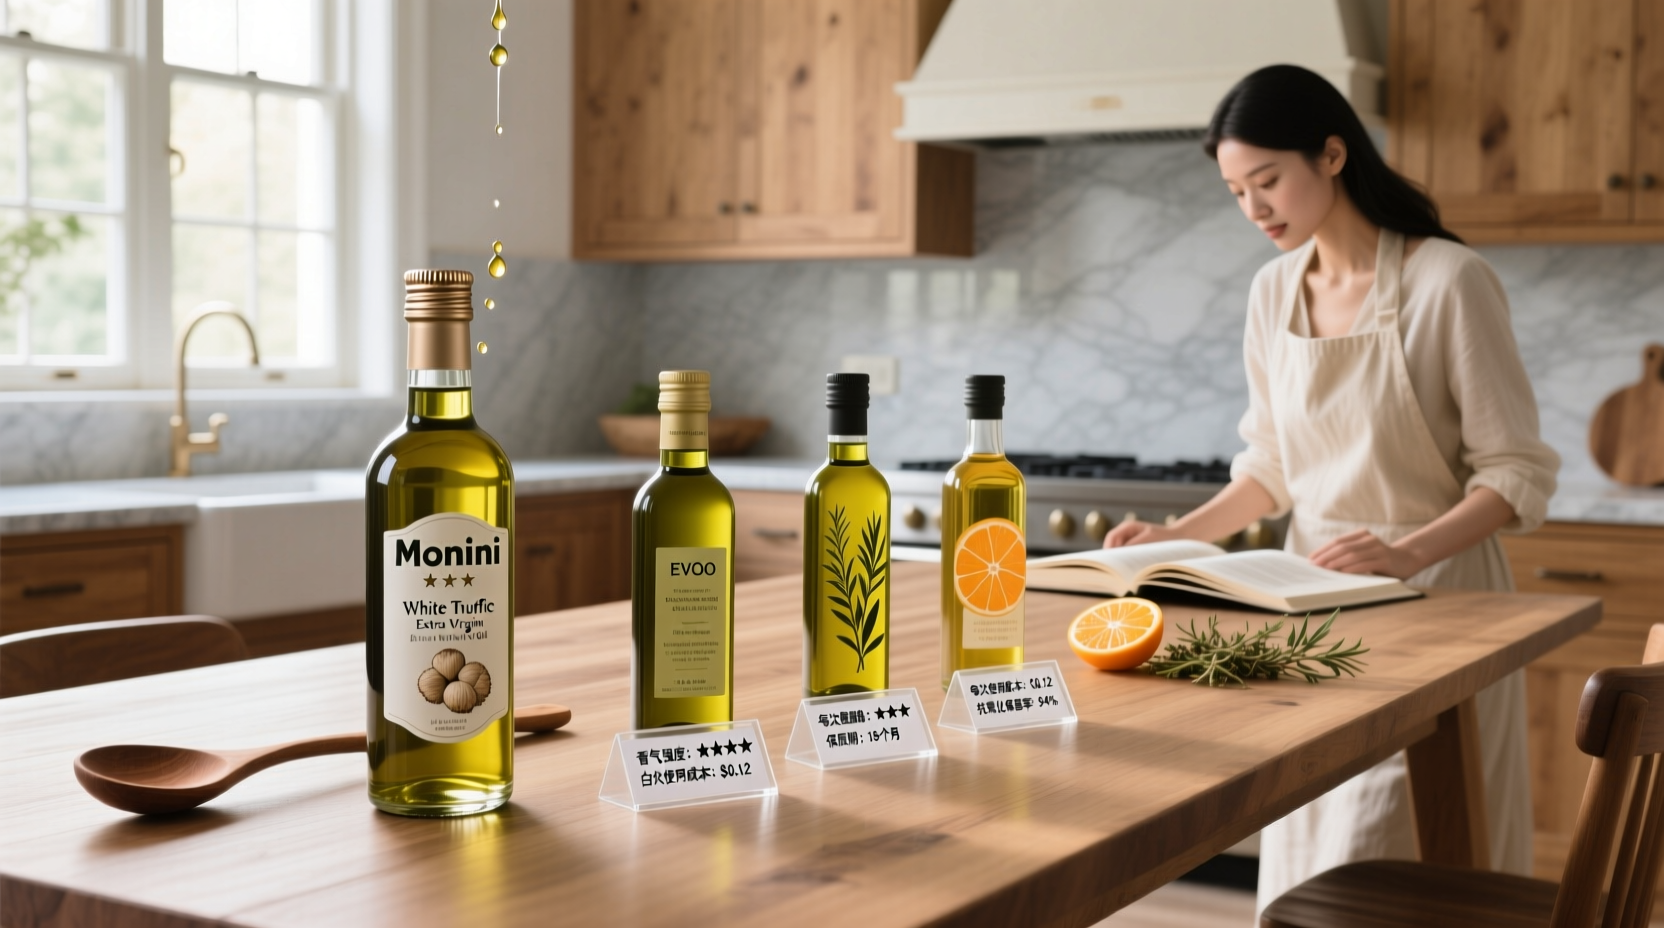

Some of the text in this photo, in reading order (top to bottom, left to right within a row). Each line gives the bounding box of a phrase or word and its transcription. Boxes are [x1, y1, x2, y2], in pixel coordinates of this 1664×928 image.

[395, 536, 500, 566] Monini
[670, 562, 716, 576] EVOO
[403, 600, 447, 615] White
[416, 619, 445, 629] Extra
